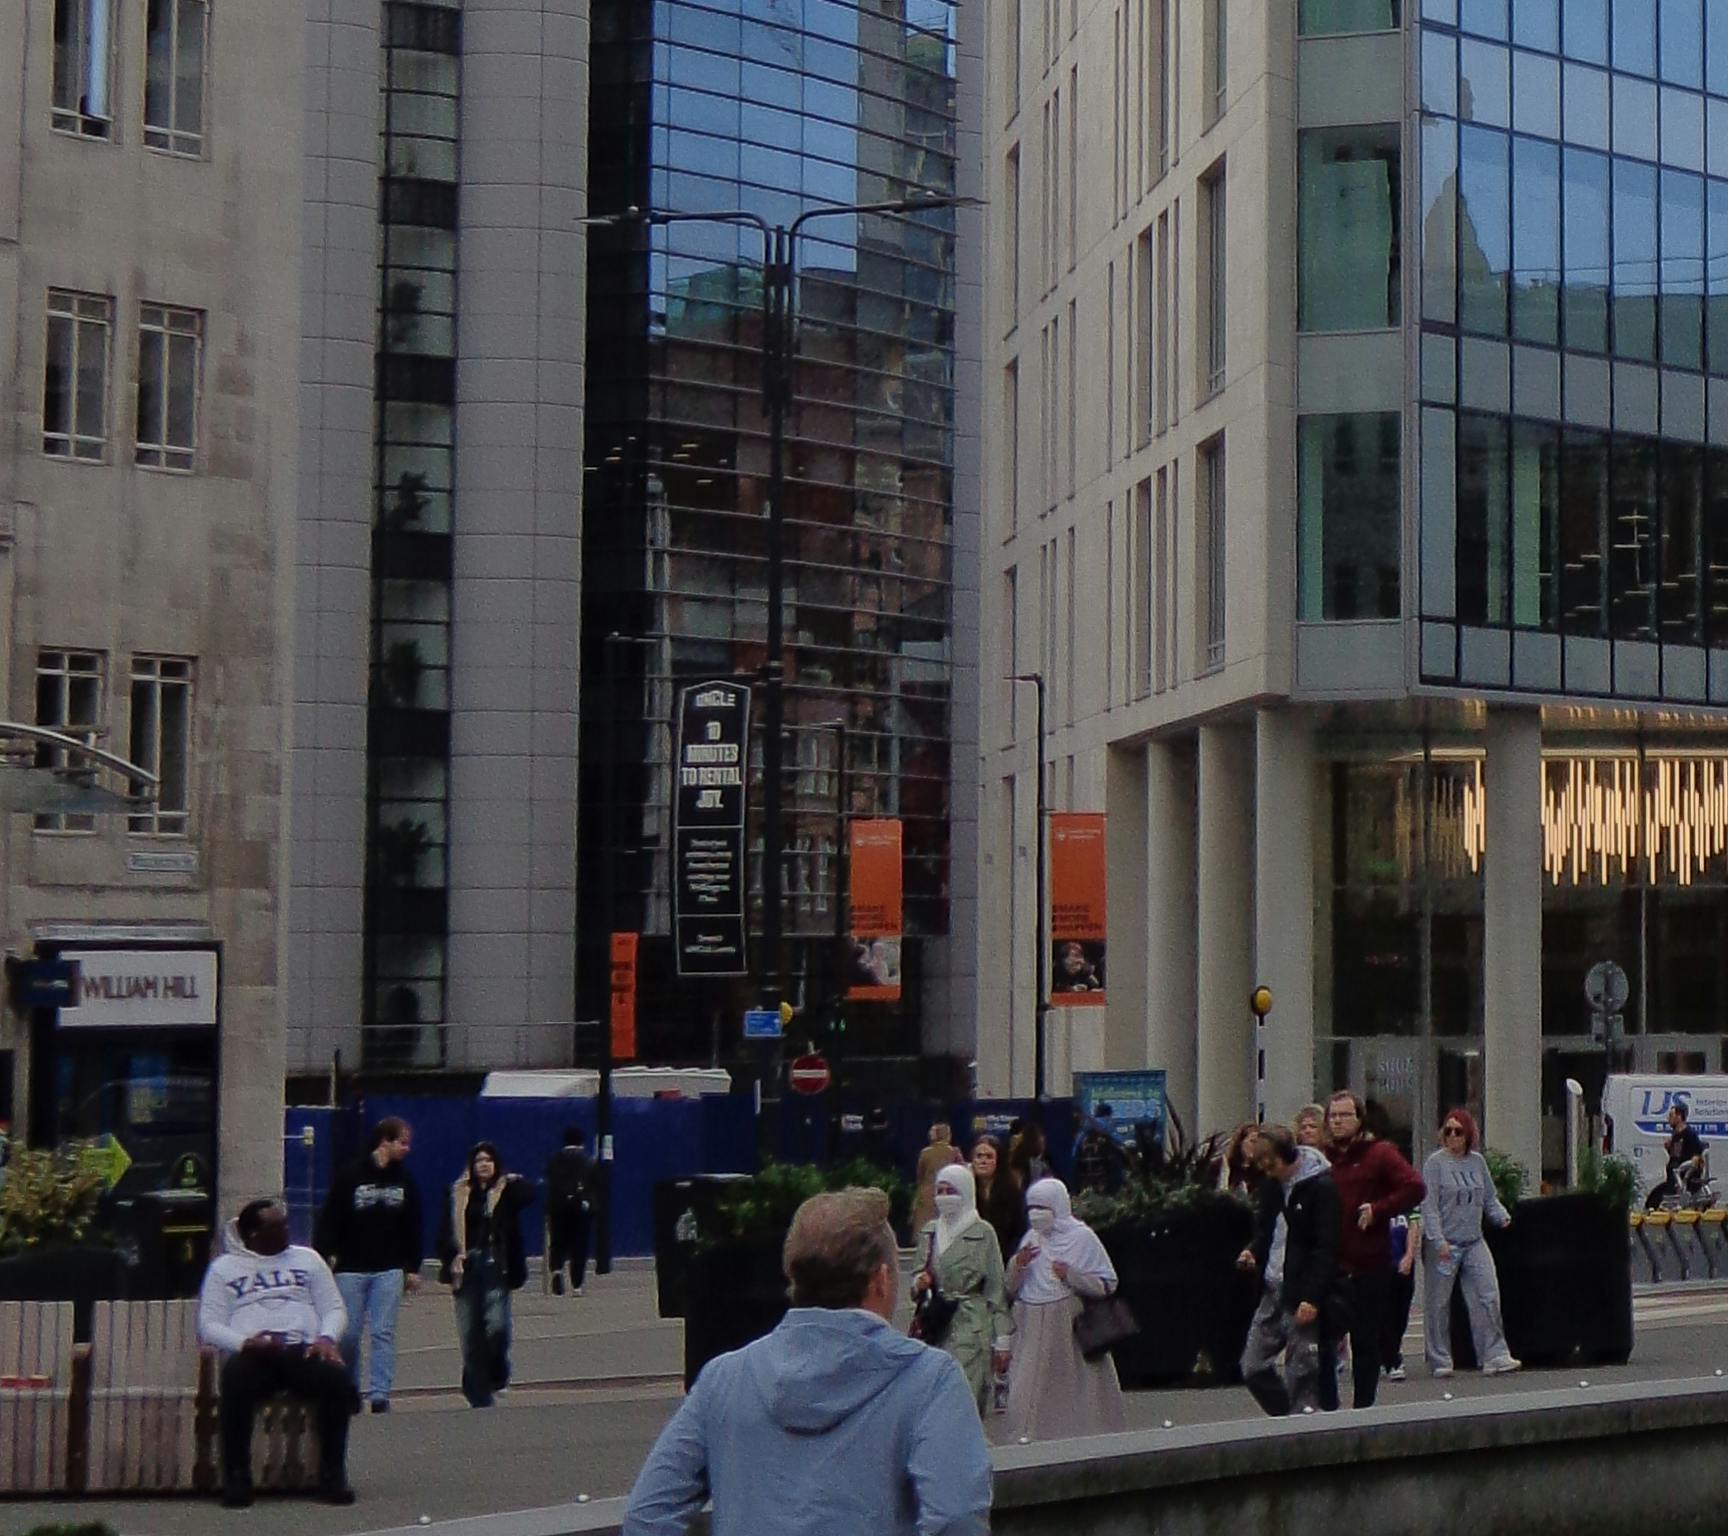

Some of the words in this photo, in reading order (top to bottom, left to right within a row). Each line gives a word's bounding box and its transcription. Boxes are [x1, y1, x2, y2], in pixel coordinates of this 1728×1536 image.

[681, 767, 697, 785] TO
[698, 766, 742, 785] RENTAL
[81, 975, 158, 999] WILLIAM
[163, 975, 199, 999] HILL
[226, 1268, 308, 1299] YALE
